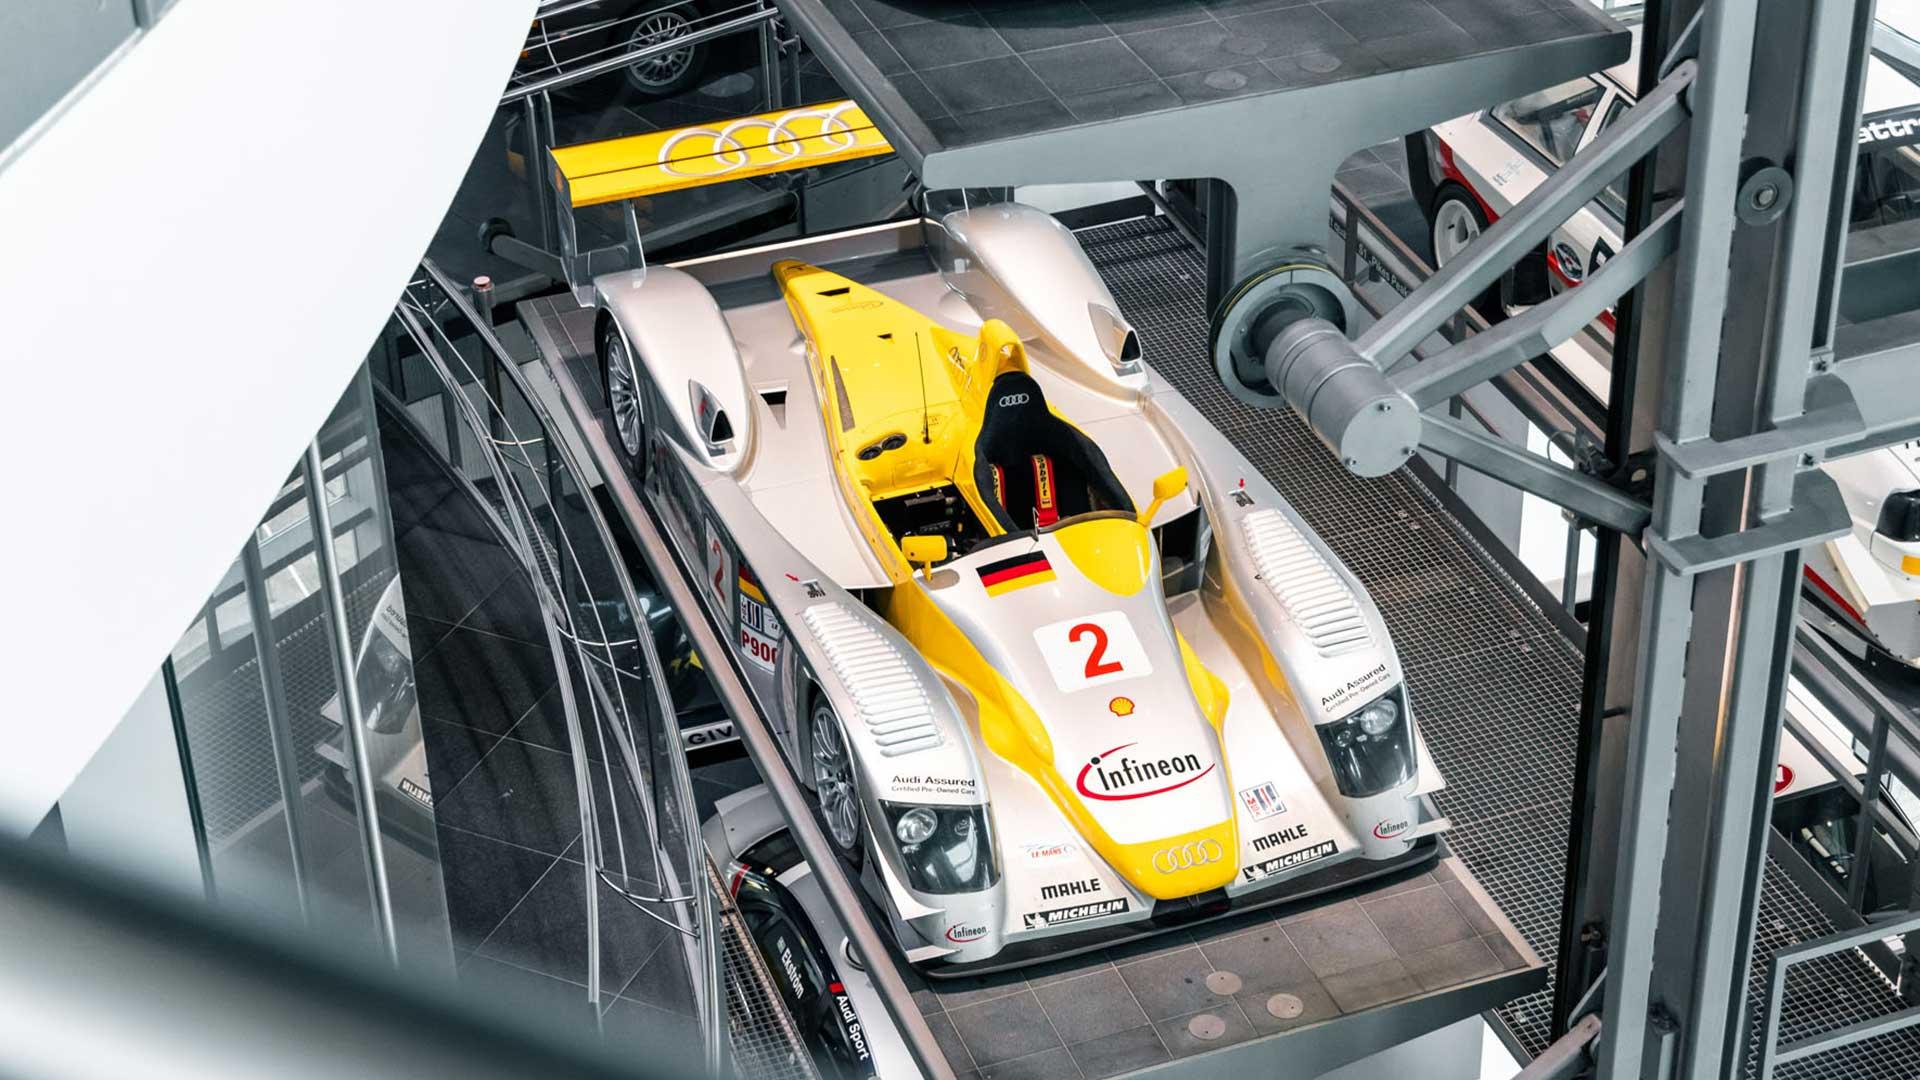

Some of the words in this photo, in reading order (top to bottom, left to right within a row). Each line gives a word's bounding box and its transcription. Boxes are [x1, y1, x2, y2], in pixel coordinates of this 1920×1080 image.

[1858, 118, 1920, 143] attr
[1068, 623, 1124, 679] 2
[1321, 687, 1345, 706] Audi
[1347, 664, 1386, 691] Assured
[892, 775, 921, 784] Audi
[924, 776, 976, 787] Assured
[960, 788, 976, 796] Cars
[1252, 824, 1308, 852] MAHLE
[1265, 843, 1333, 872] MICHELIN
[1041, 878, 1101, 900] MAHLE
[1047, 900, 1124, 922] MICHELIN
[781, 947, 804, 1000] Ekström
[836, 995, 857, 1022] Audi
[849, 1023, 870, 1061] Sport
